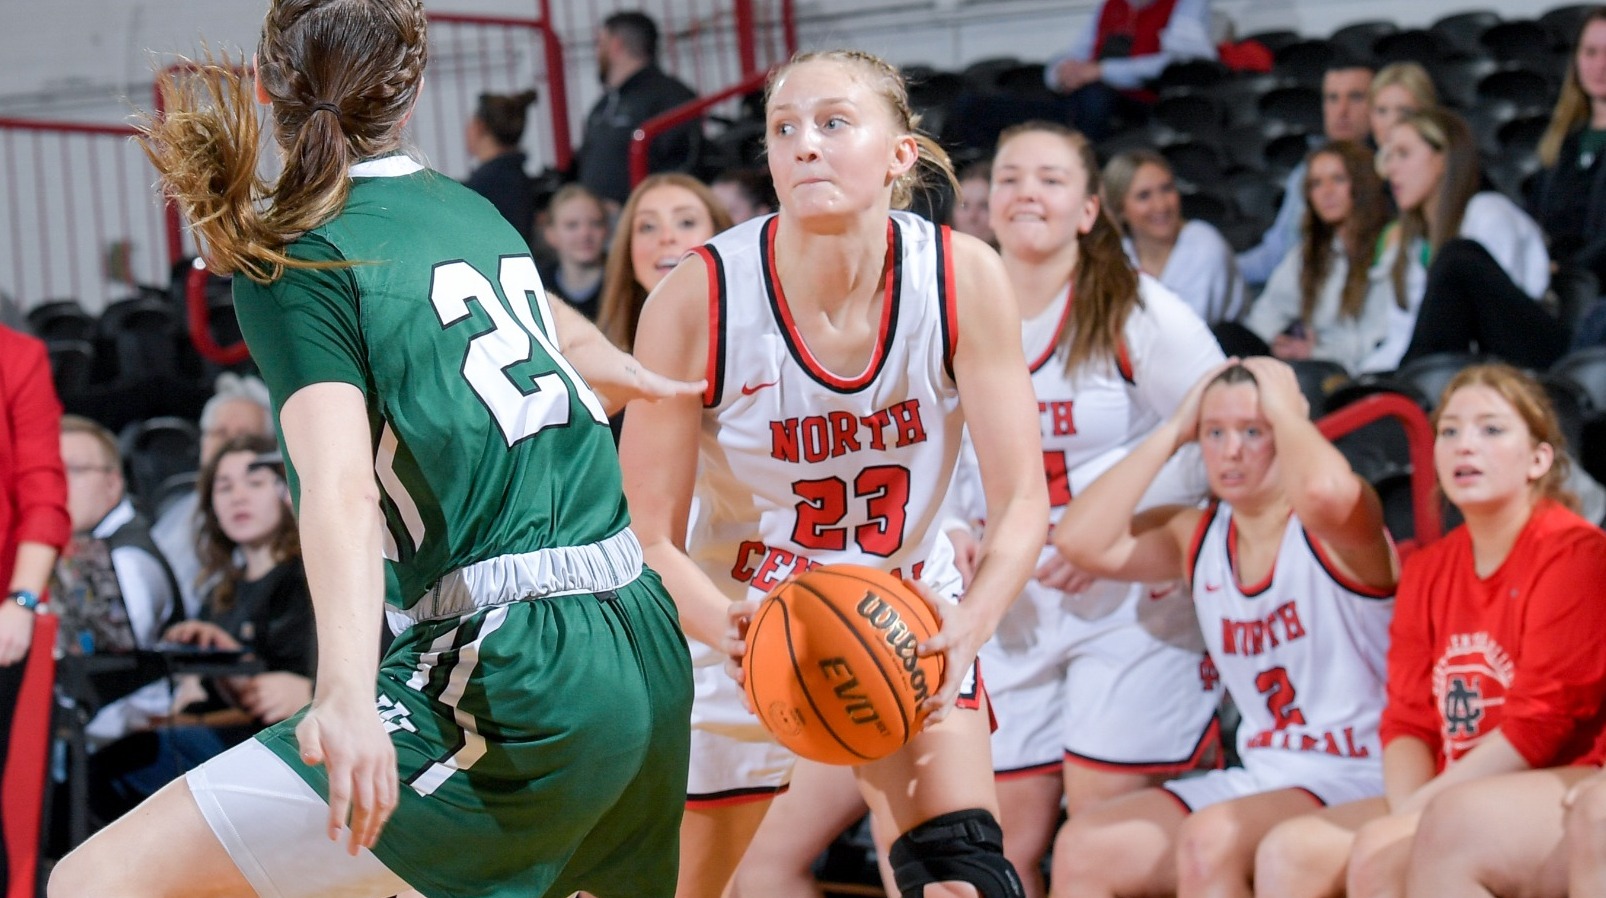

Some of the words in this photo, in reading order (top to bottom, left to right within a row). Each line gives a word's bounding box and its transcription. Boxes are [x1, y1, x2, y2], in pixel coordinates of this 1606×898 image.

[428, 253, 609, 451] 20
[769, 399, 927, 463] NORTH
[790, 464, 911, 558] 23
[818, 656, 881, 725] EVO
[856, 590, 929, 713] Wilson
[1255, 666, 1307, 730] 2
